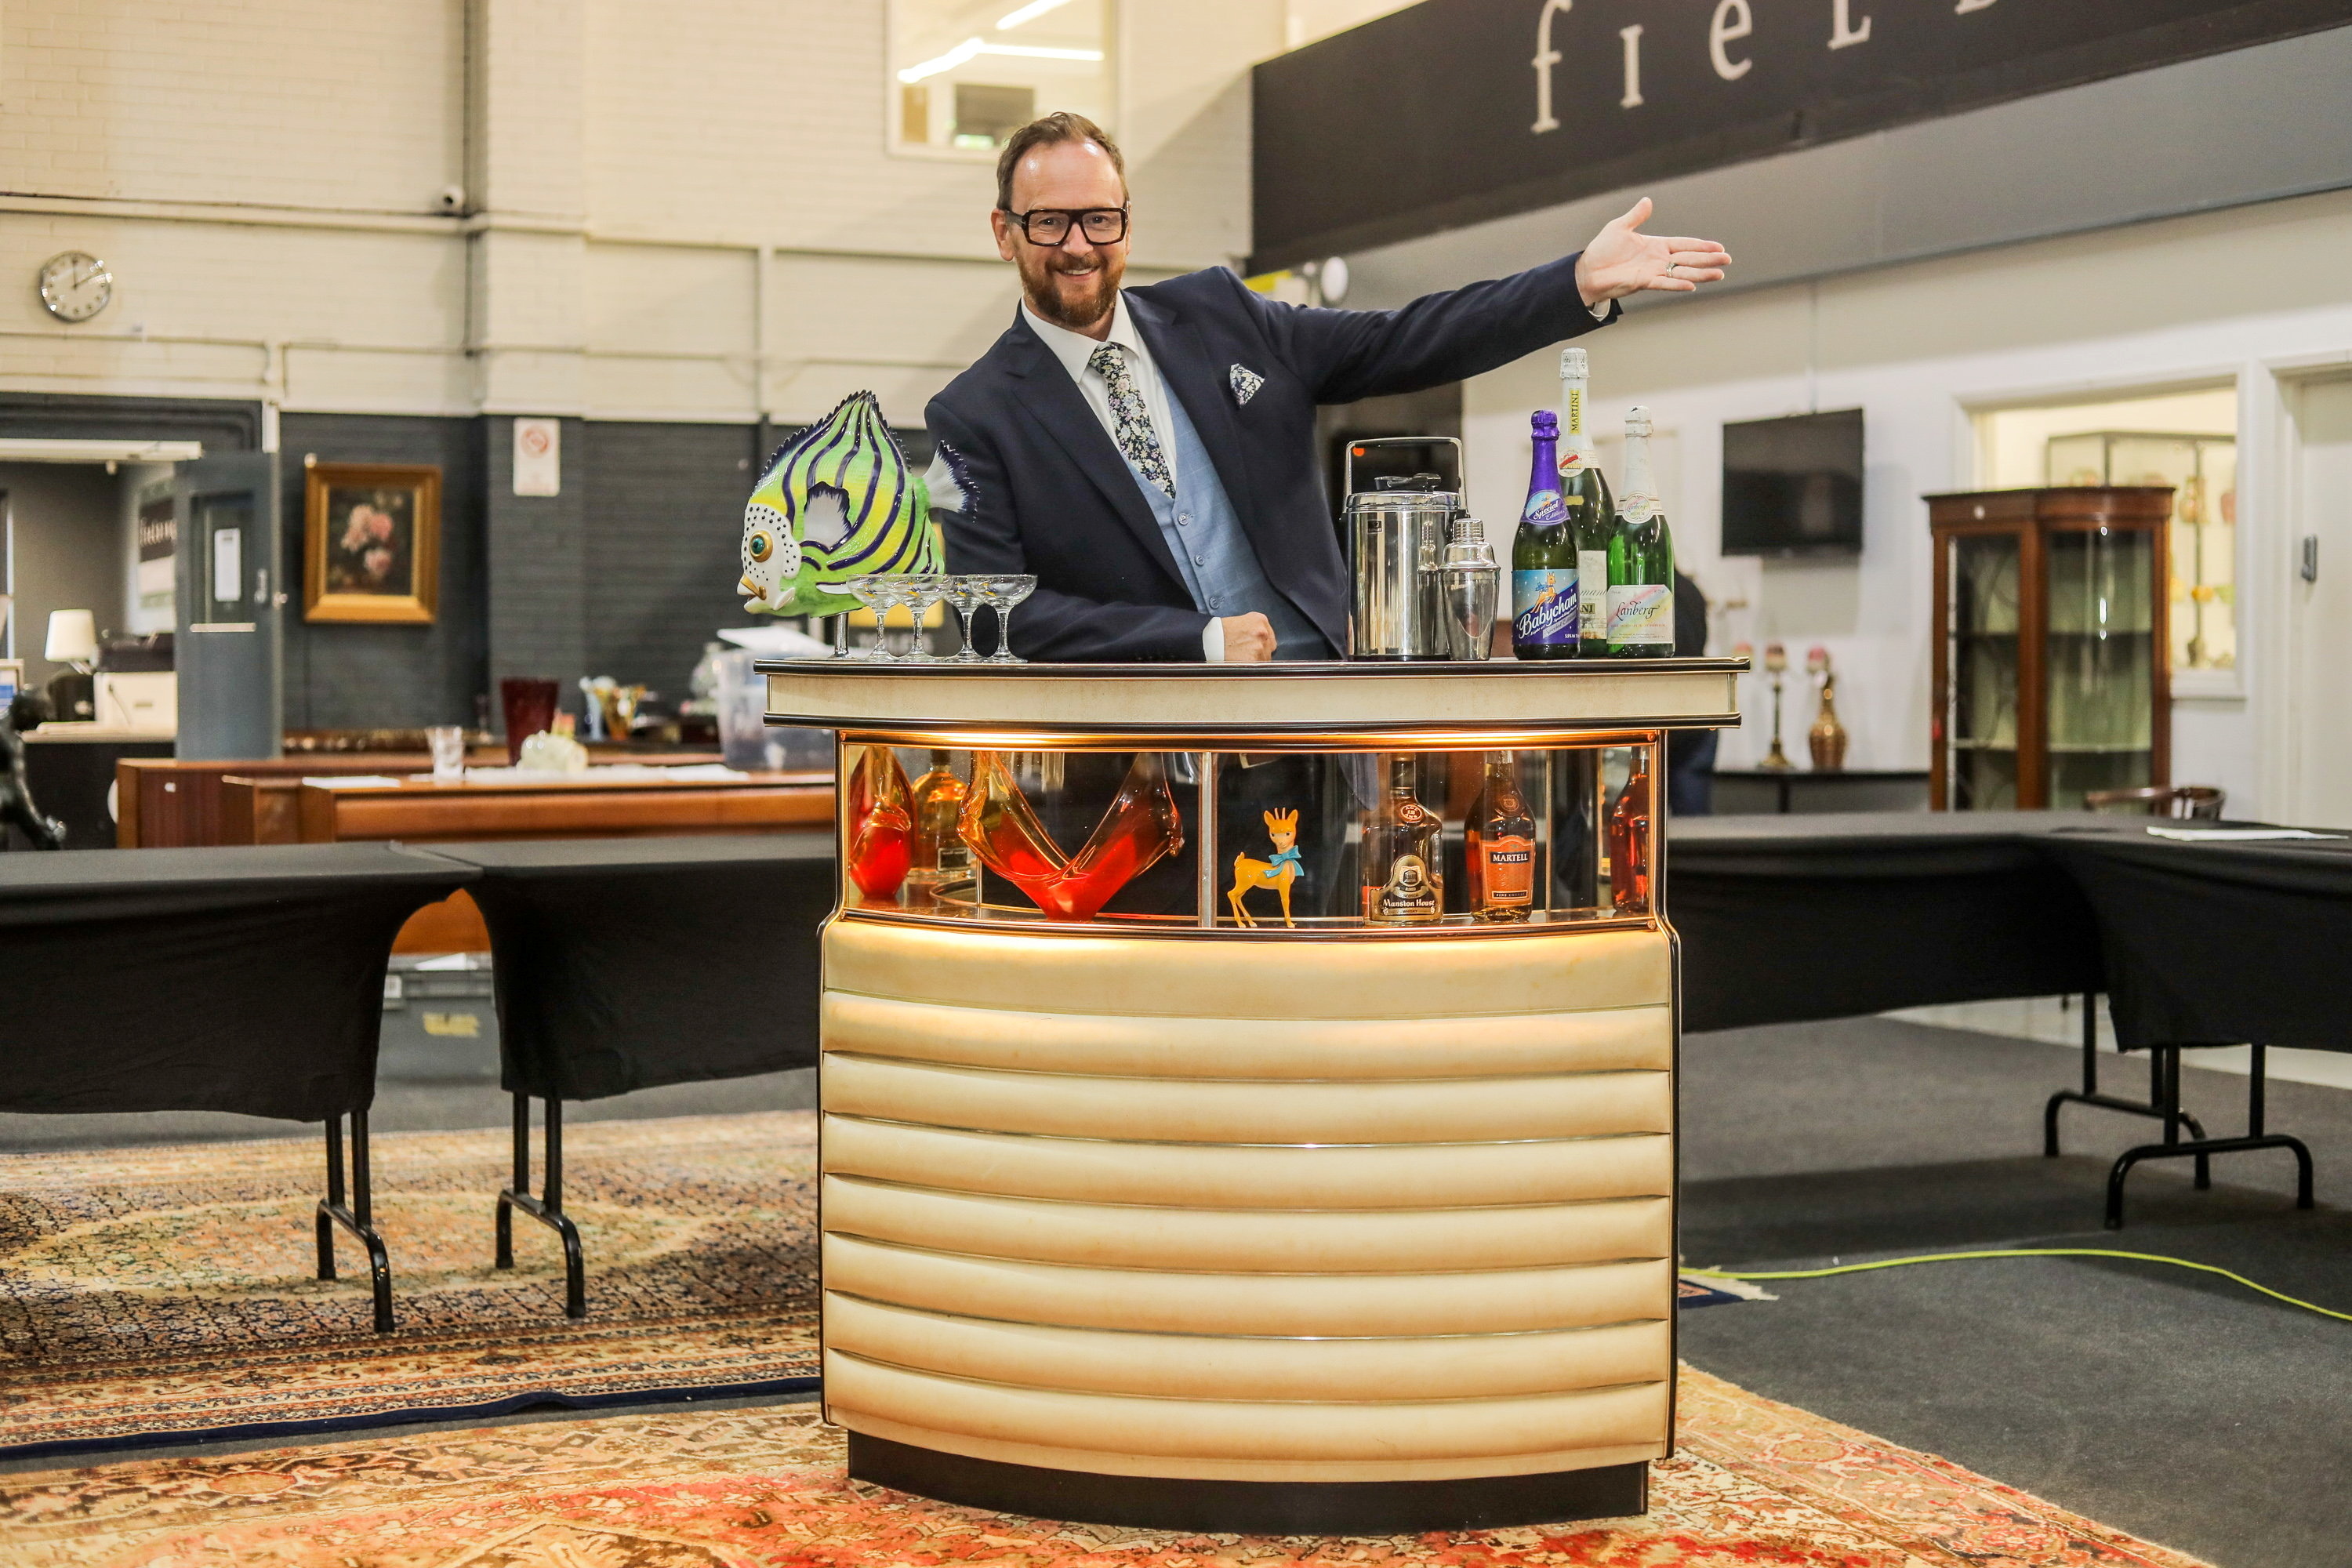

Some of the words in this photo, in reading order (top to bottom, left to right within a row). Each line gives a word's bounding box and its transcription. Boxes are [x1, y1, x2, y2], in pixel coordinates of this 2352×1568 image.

[1533, 499, 1559, 520] Special
[1519, 593, 1577, 639] Babycham
[1616, 601, 1661, 621] Lanberg
[1493, 853, 1528, 862] MARTELL
[1383, 898, 1414, 907] Mansion
